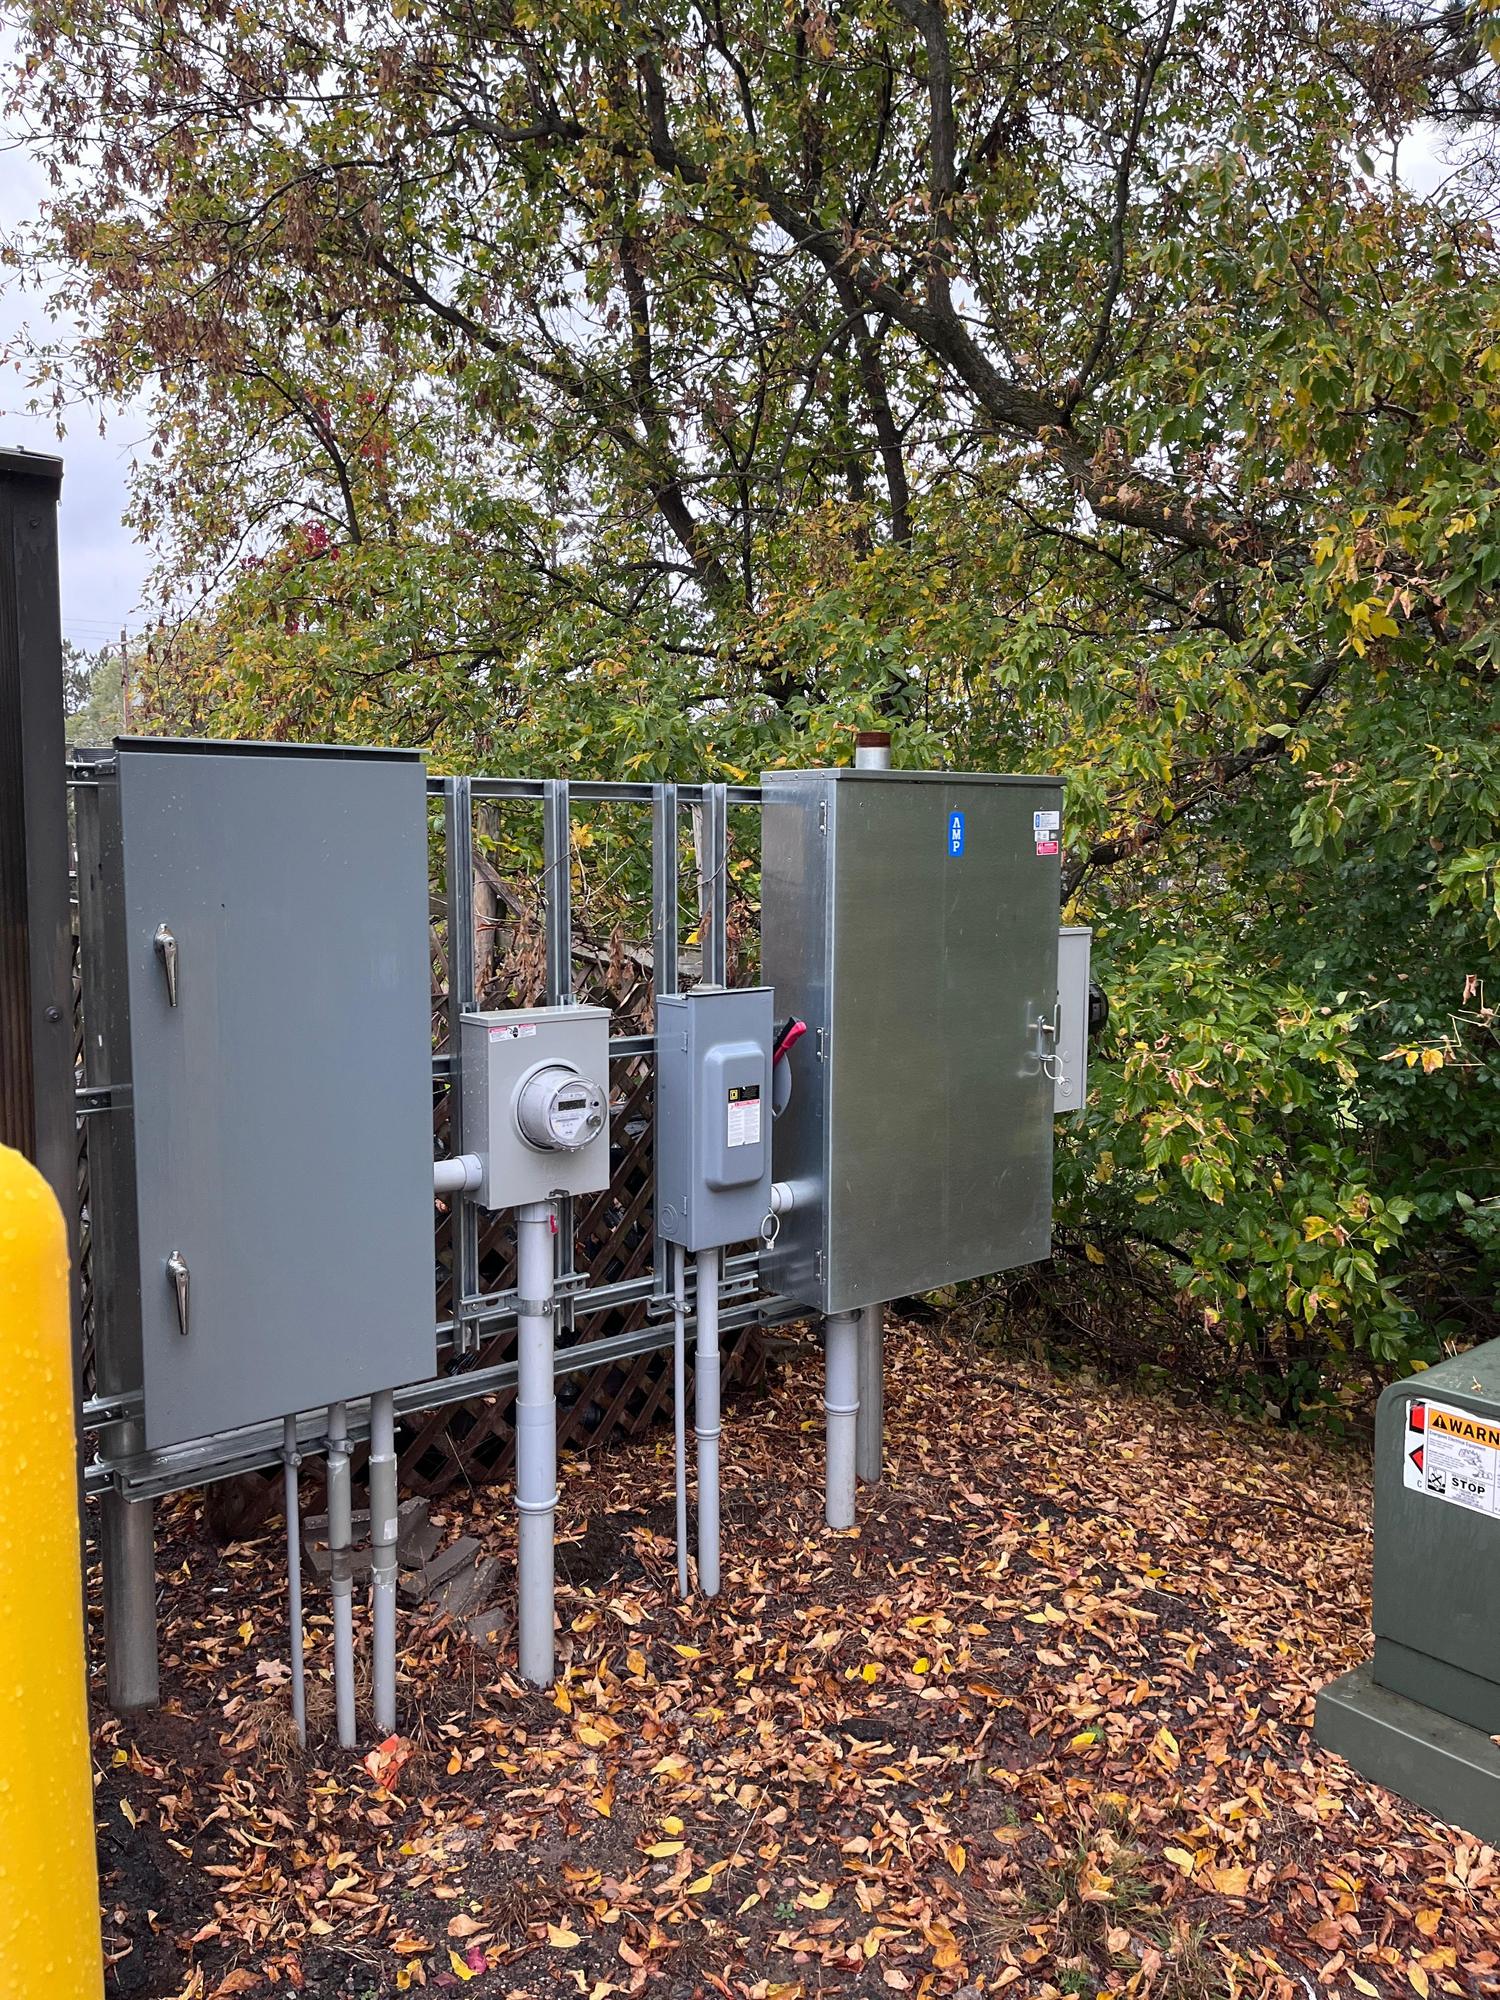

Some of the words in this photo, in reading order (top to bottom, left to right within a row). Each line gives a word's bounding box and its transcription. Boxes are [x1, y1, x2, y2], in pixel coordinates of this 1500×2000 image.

[952, 817, 961, 852] AMP
[1449, 1418, 1500, 1446] WARN
[1452, 1477, 1485, 1494] STOP
